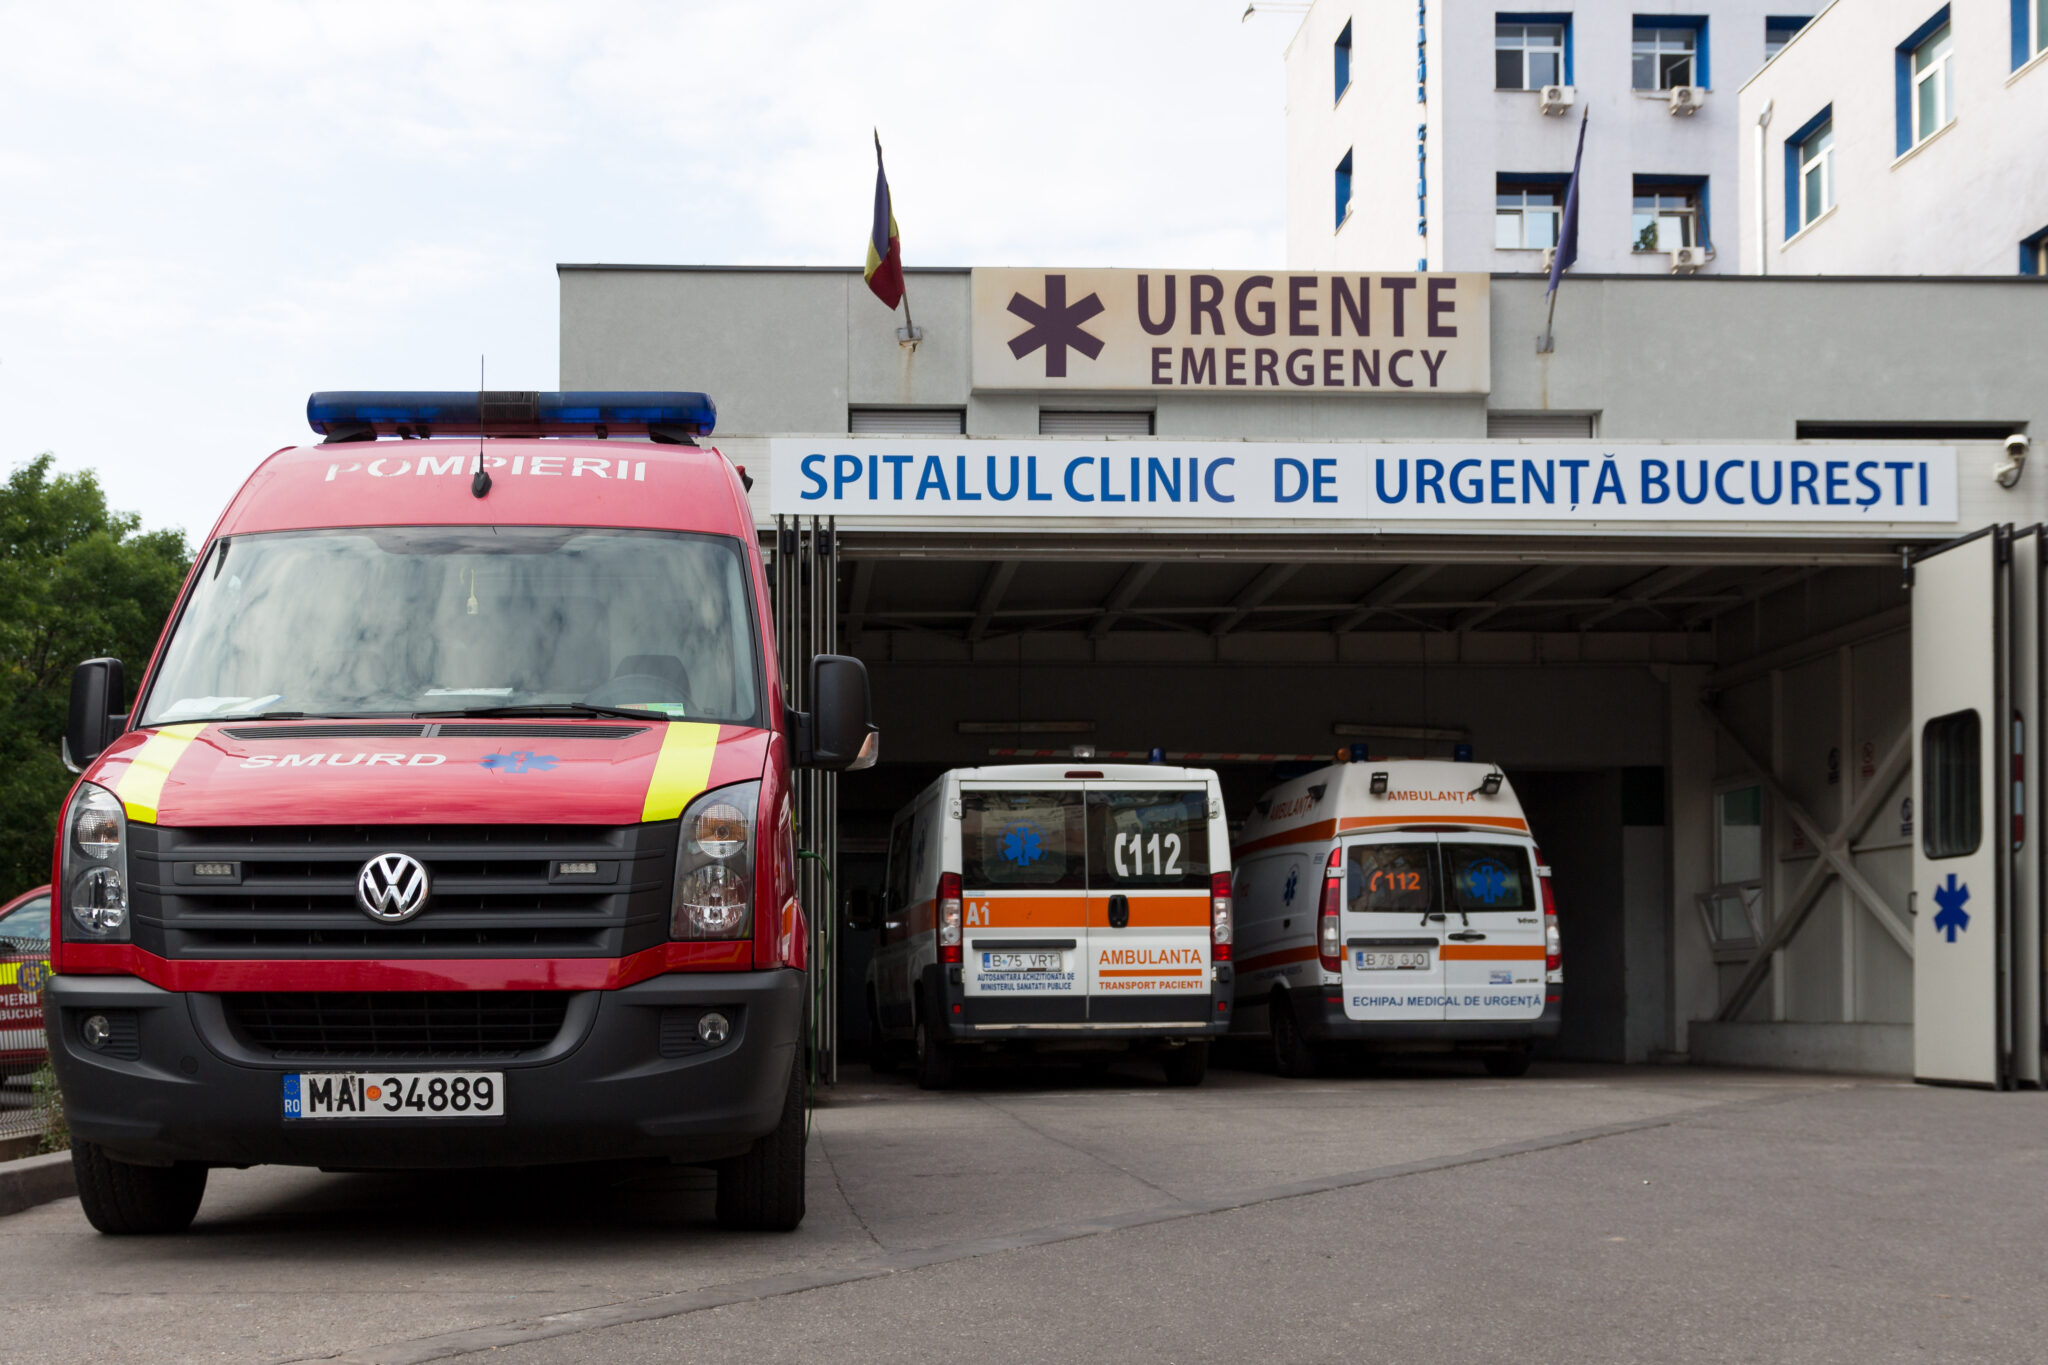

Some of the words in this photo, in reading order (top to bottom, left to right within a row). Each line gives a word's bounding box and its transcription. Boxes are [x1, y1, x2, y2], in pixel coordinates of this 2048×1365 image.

[1137, 274, 1457, 338] URGENTE
[1151, 347, 1449, 388] EMERGENCY
[324, 454, 647, 483] POMPIERII
[800, 454, 1053, 502] SPITALUL
[1063, 456, 1236, 503] CLINIC
[1274, 457, 1339, 504] DE
[1375, 453, 1627, 512] URGENȚĂ
[1640, 458, 1929, 513] BUCUREȘTI
[239, 752, 447, 769] SMURD
[1384, 871, 1421, 891] 112
[966, 901, 990, 926] A1
[1098, 949, 1202, 965] AMBULANTA
[1098, 981, 1156, 990] TRANSPORT
[1159, 980, 1203, 989] PACIENTI
[1352, 995, 1403, 1007] ECHIPAJ
[1407, 995, 1461, 1007] MEDICAL
[1463, 995, 1480, 1006] DE
[309, 1077, 366, 1112] MAI
[382, 1076, 494, 1112] 34889
[284, 1099, 300, 1113] RO
